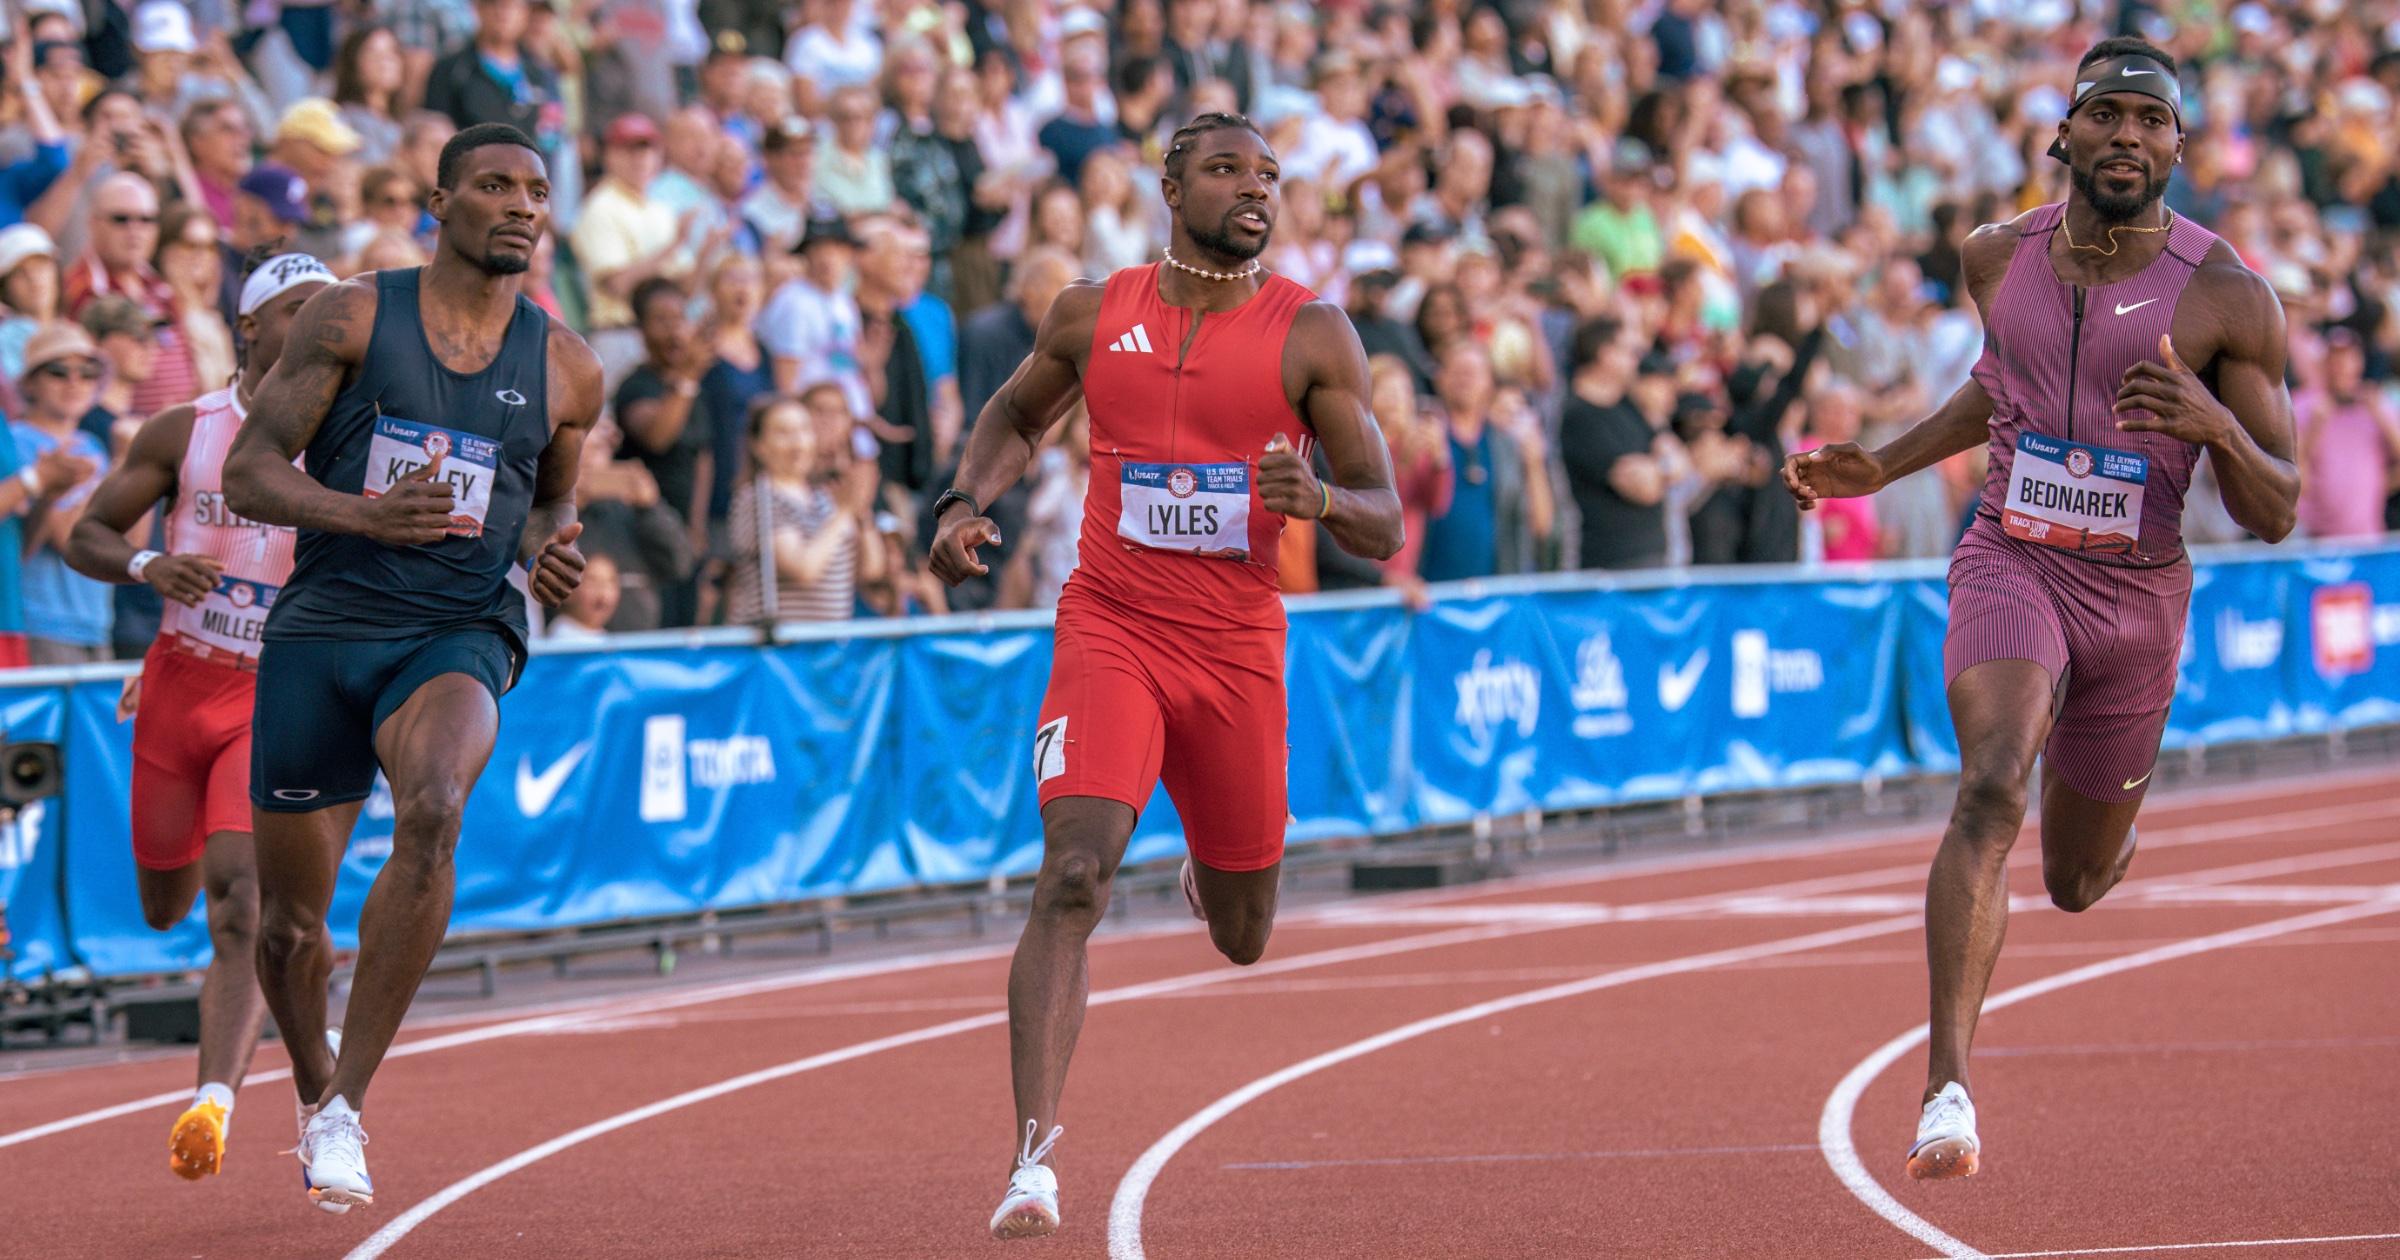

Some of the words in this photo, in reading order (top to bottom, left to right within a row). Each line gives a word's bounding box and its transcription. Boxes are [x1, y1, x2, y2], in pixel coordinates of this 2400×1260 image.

[2035, 443, 2060, 455] USATF
[1137, 472, 1161, 480] USATF
[2103, 462, 2120, 471] TEAM
[2120, 464, 2141, 475] TRIALS
[1207, 475, 1222, 484] TEAM
[1223, 475, 1243, 483] TRIALS
[2020, 476, 2129, 518] BEDNAREK
[1148, 504, 1219, 536] LYLES
[2009, 515, 2051, 533] TRACKTOWN
[1037, 724, 1059, 782] 7
